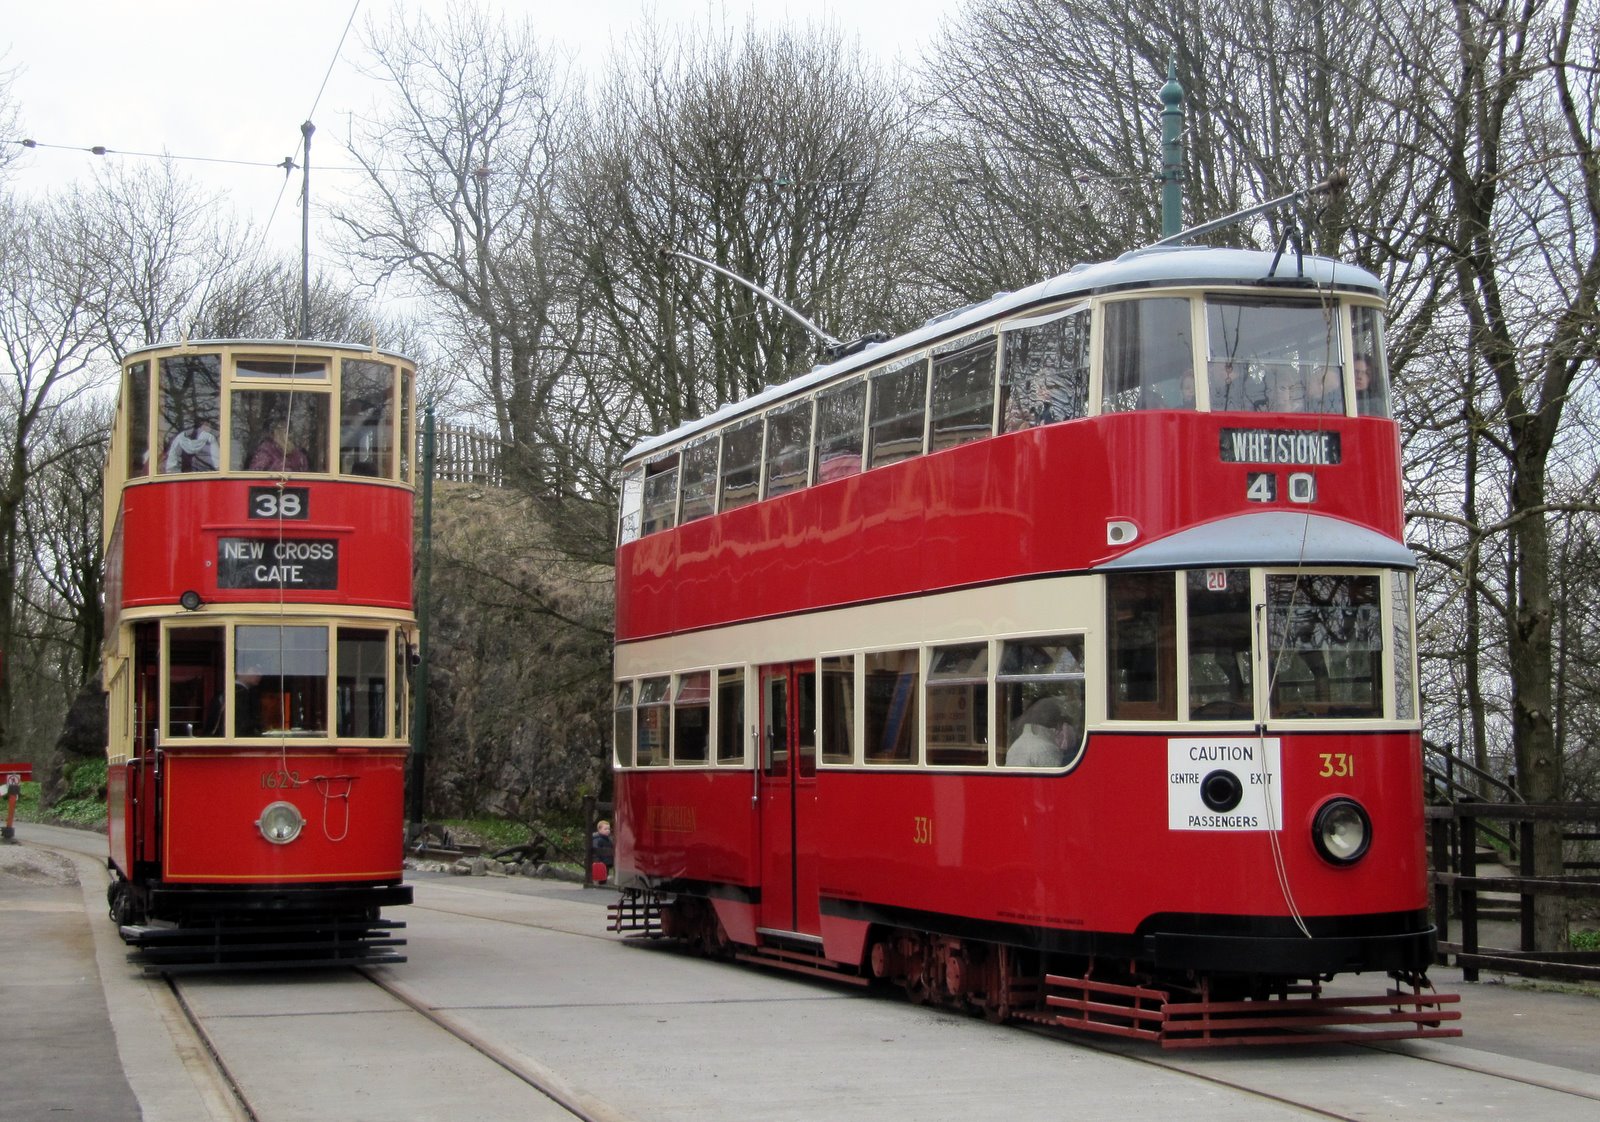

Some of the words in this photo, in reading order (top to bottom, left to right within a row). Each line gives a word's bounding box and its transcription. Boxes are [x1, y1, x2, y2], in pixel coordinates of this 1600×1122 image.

[1231, 432, 1330, 465] WHETSTONE
[255, 493, 302, 517] 38
[224, 542, 265, 560] NEW
[273, 543, 334, 560] CROSS
[254, 565, 304, 582] GATE
[1208, 571, 1225, 589] 20
[1189, 746, 1253, 761] CAUTION
[1319, 753, 1354, 777] 331
[1170, 773, 1200, 785] CENTRE
[1250, 773, 1273, 785] EXIT
[1188, 815, 1258, 827] PASSENGERS
[913, 816, 932, 845] 331
